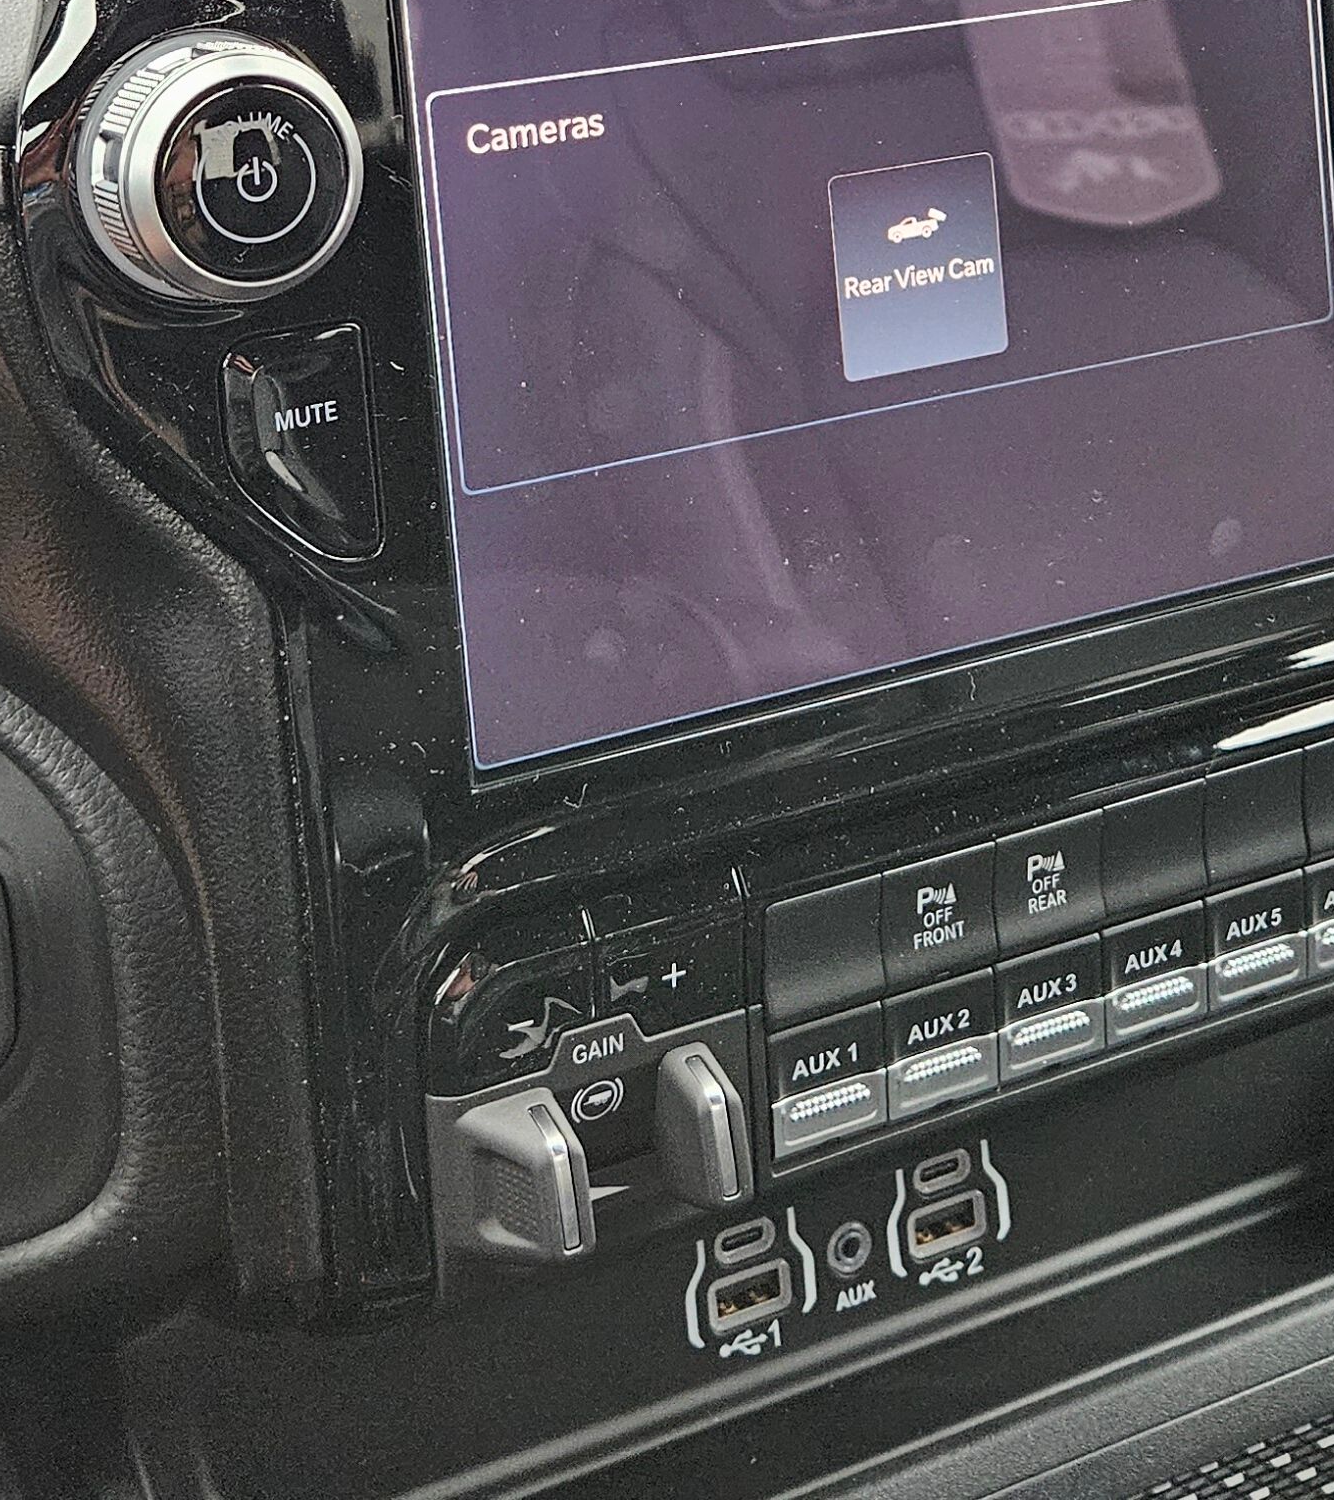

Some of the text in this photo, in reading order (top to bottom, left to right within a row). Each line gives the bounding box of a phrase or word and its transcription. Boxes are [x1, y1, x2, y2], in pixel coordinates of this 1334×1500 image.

[467, 113, 605, 154] Cameras
[844, 258, 995, 299] Rear View Cam
[275, 401, 338, 432] MUTE
[1031, 873, 1061, 894] OFF
[923, 906, 954, 929] OFF
[1028, 889, 1068, 914] REAR
[913, 920, 965, 950] FRONT
[1226, 908, 1283, 941] AUX 5
[1124, 939, 1183, 975] AUX 4
[1017, 973, 1078, 1009] AUX 3
[907, 1008, 971, 1046] AUX 2
[572, 1032, 626, 1065] GAIN
[792, 1042, 859, 1082] AUX 1
[966, 1246, 985, 1276] 2
[836, 1280, 877, 1312] AUX
[767, 1319, 782, 1348] 1
